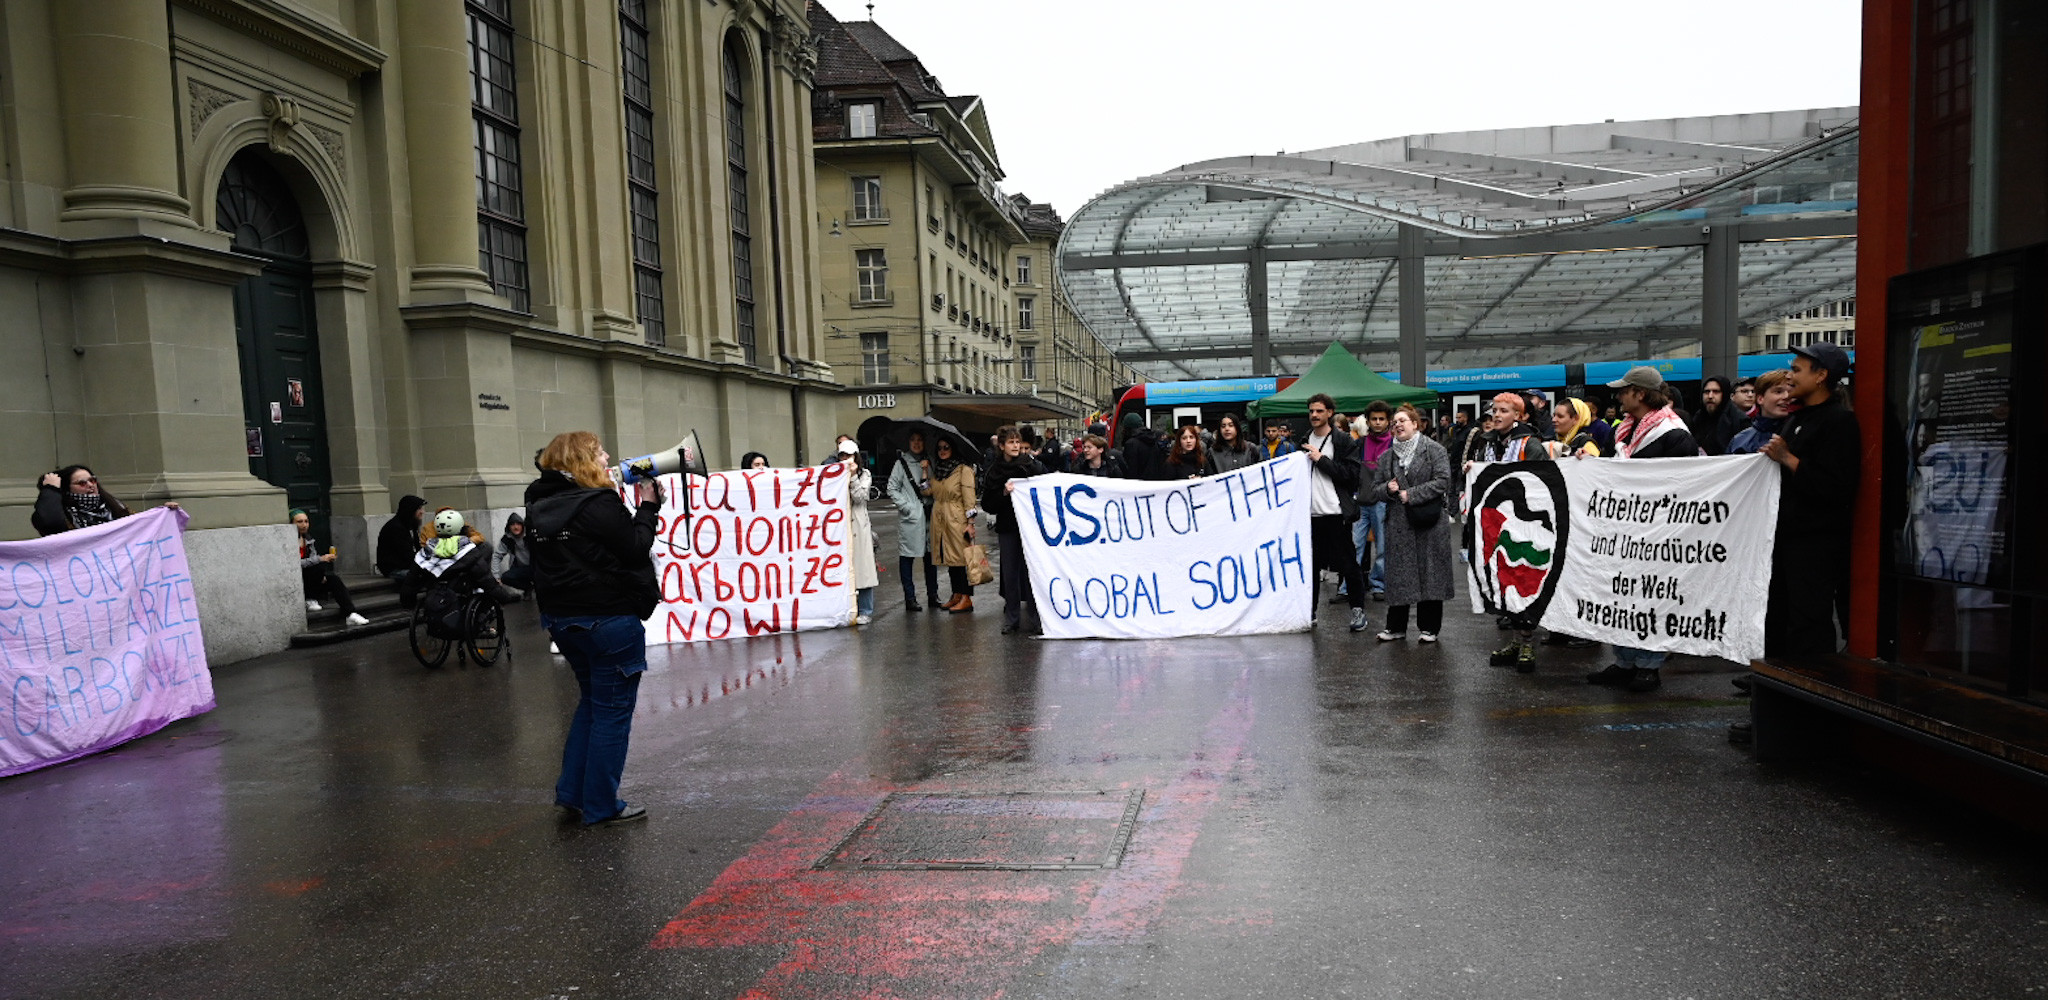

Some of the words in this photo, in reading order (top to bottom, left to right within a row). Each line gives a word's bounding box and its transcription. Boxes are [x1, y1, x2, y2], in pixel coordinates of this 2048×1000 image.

[857, 393, 896, 409] LOEB
[1104, 494, 1156, 543] OUT
[1165, 483, 1208, 535] OF
[1215, 457, 1292, 522] THE
[1591, 533, 1618, 556] und
[1049, 572, 1175, 620] GLOBAL
[1189, 532, 1305, 610] SOUTH
[1612, 571, 1637, 597] der
[1641, 574, 1684, 605] Welt,
[1577, 599, 1657, 641] vereinigt
[1666, 609, 1727, 641] euch!
